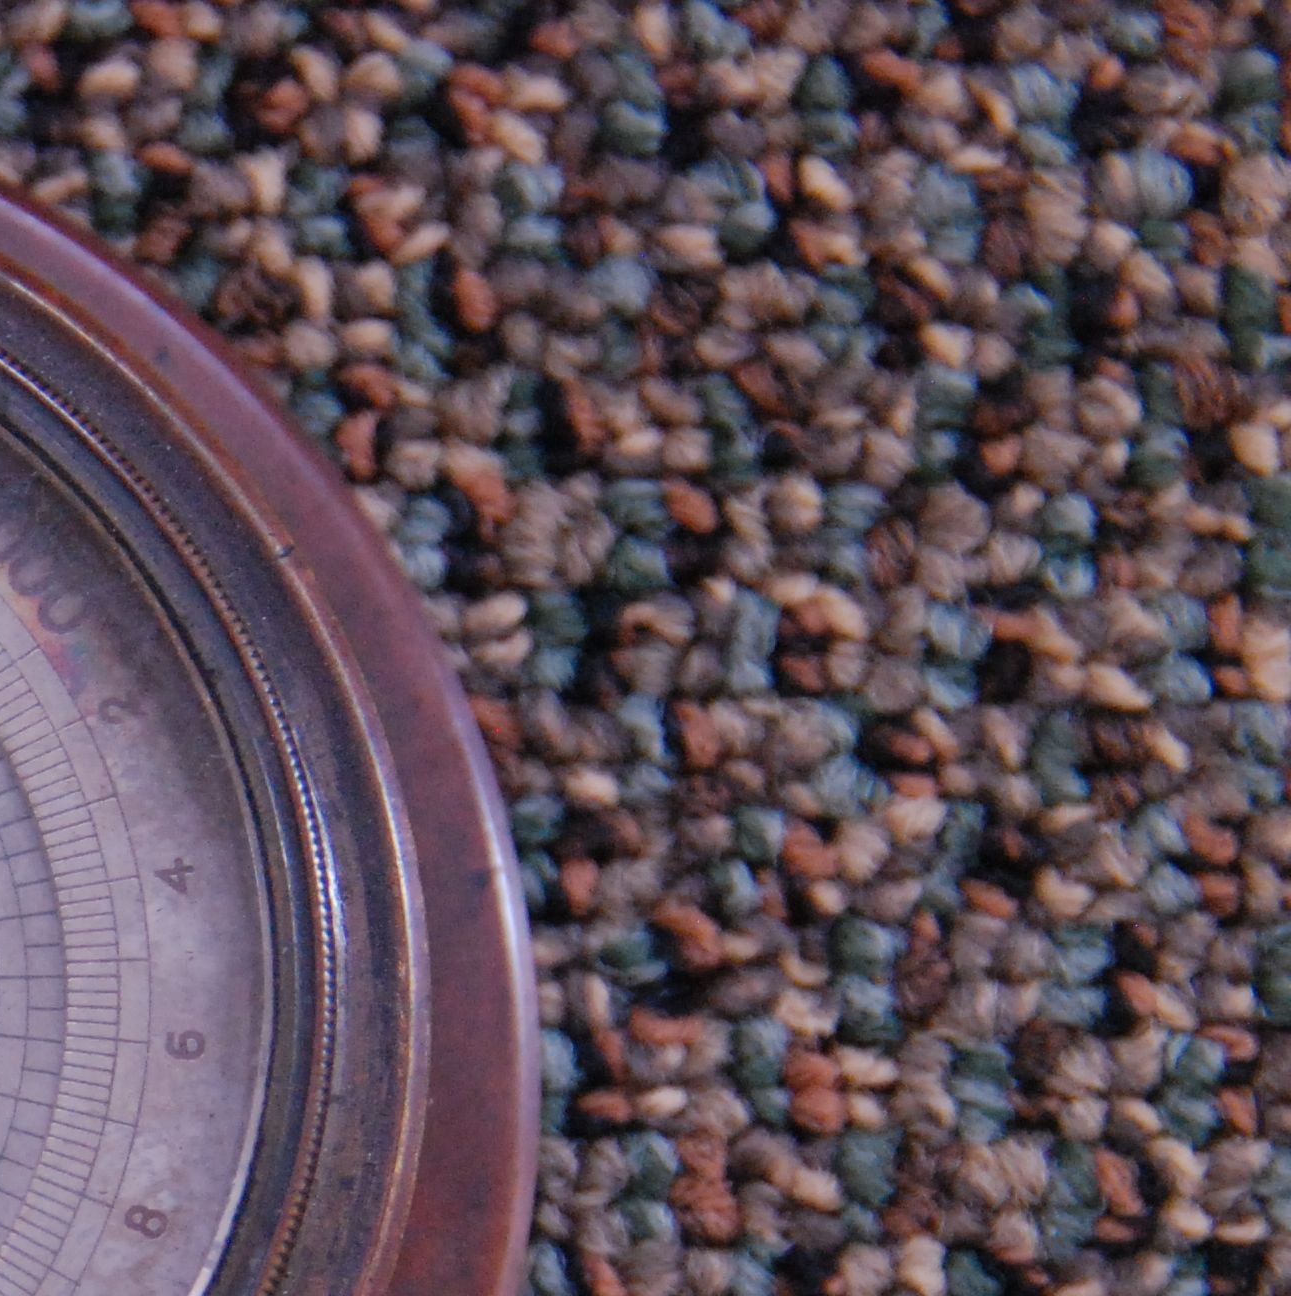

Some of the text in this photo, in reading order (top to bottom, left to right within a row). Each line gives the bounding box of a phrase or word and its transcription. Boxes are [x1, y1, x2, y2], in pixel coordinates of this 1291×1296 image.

[154, 857, 195, 895] 4
[164, 1027, 207, 1062] 6
[123, 1205, 168, 1240] 8
